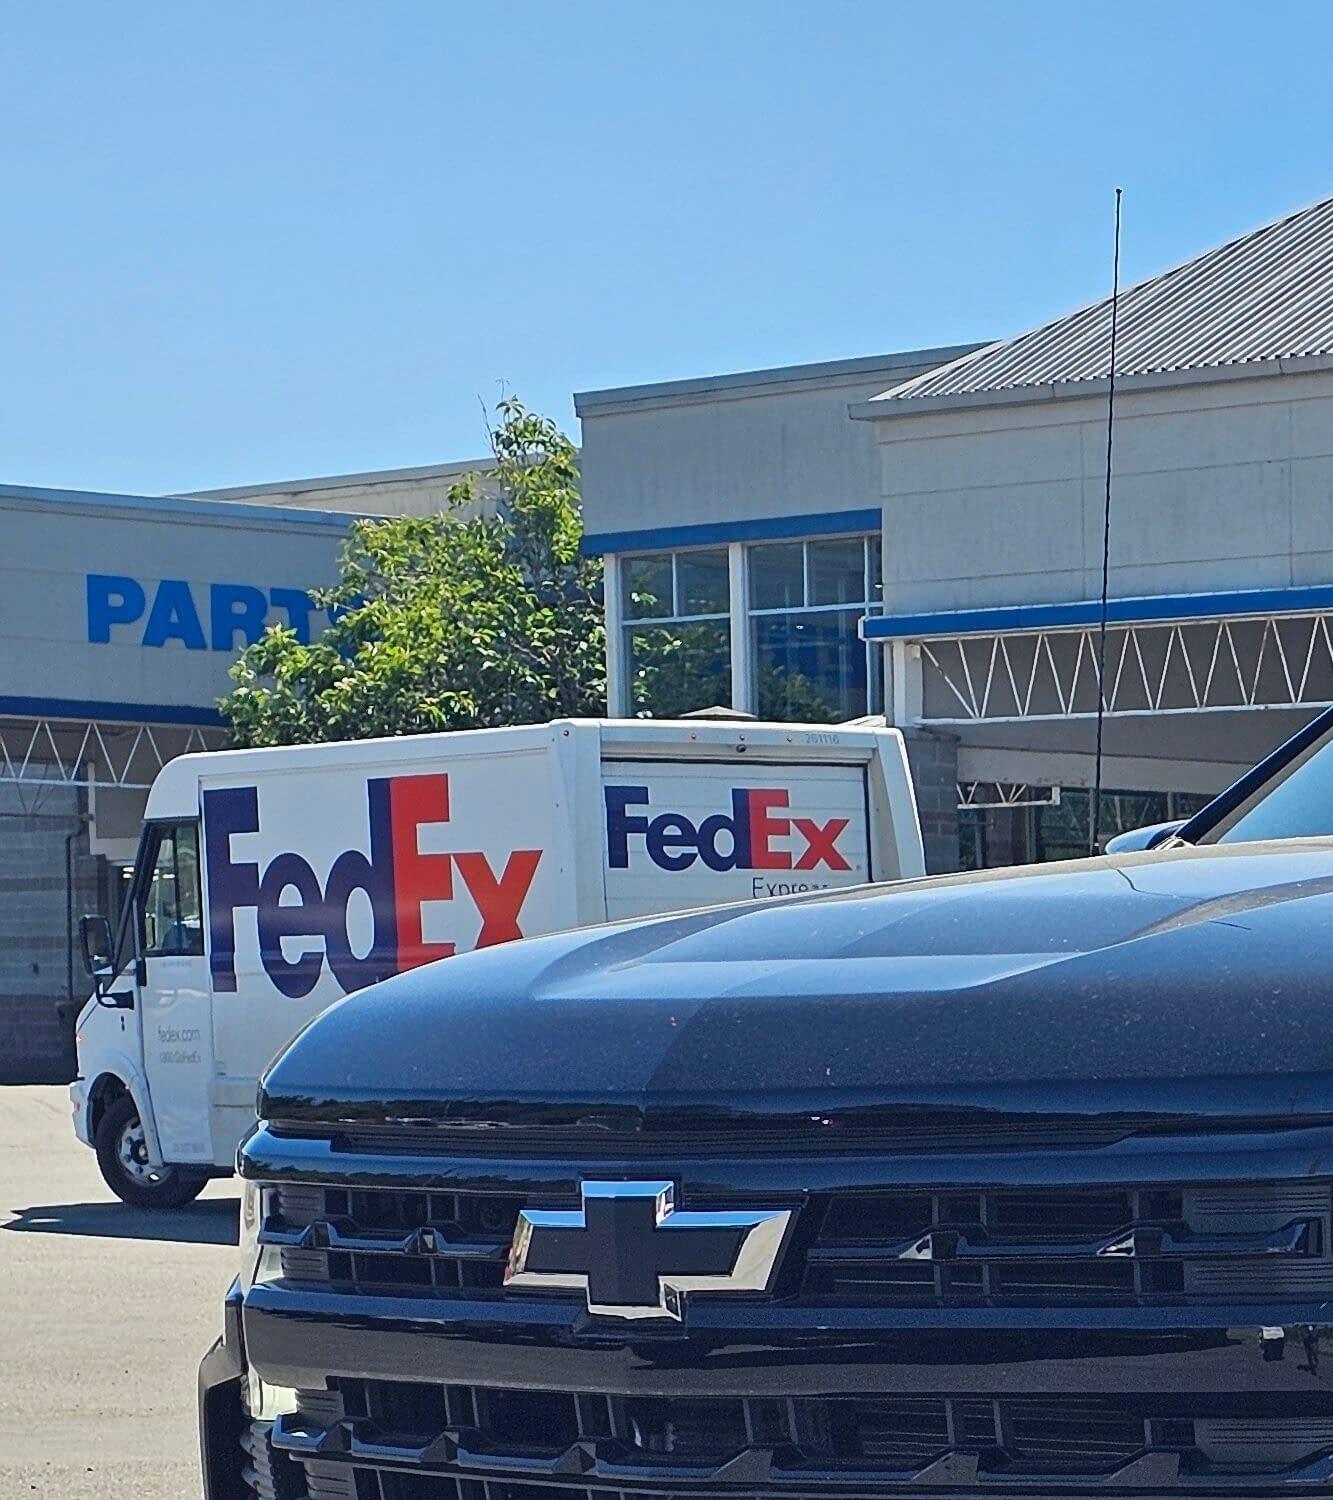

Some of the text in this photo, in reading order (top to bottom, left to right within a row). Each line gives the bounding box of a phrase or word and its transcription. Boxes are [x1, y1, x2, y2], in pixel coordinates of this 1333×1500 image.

[604, 785, 852, 871] FedEx
[203, 773, 544, 999] FedEx
[752, 876, 828, 899] Expre
